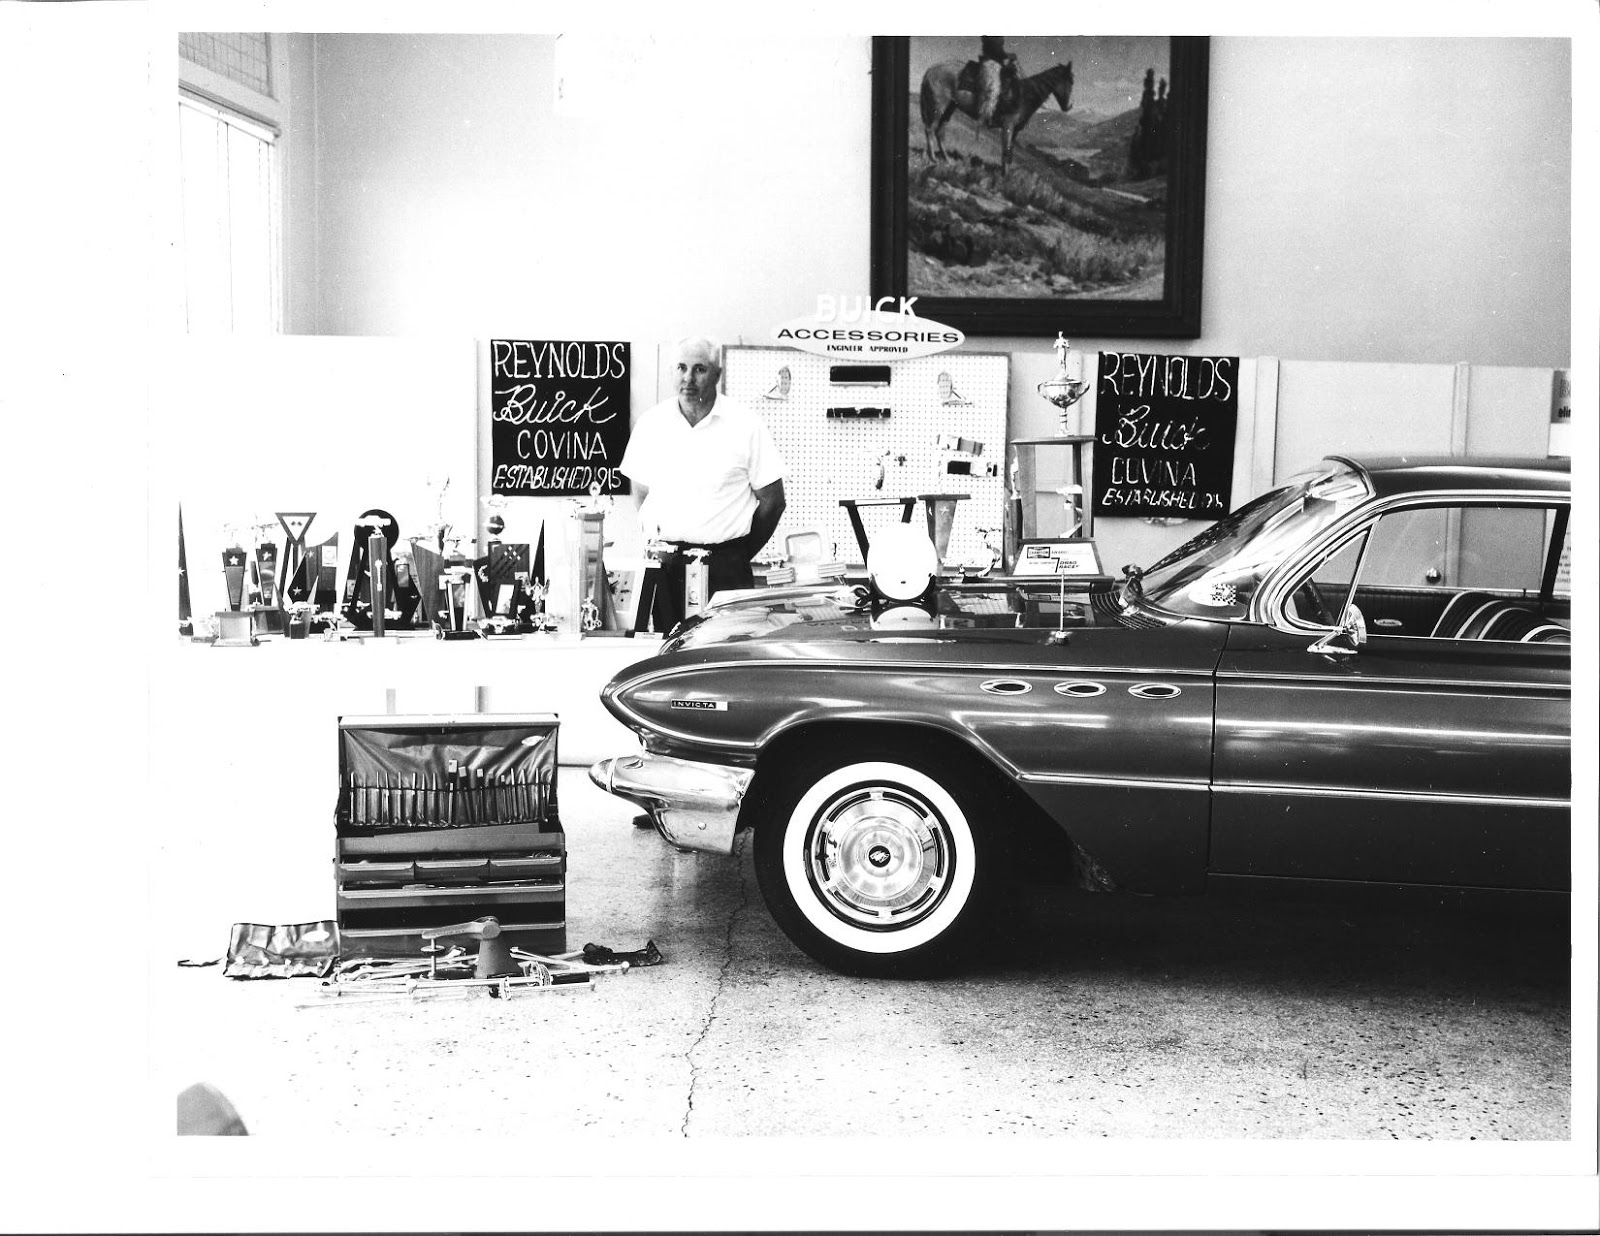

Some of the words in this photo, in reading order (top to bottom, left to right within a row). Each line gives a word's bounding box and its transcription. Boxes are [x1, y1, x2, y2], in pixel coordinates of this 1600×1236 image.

[816, 294, 919, 323] BUICK
[777, 328, 959, 343] ACCESSORIES
[826, 344, 863, 352] ENGINEER
[869, 345, 908, 353] APPROVED
[492, 340, 626, 379] REYNOLDS
[1101, 351, 1231, 401] REYNOLDS
[493, 384, 617, 425] Buick
[1102, 404, 1211, 450] Buick
[518, 429, 607, 460] COVINA
[493, 464, 592, 489] ESTABLISHED
[1112, 456, 1197, 487] COVINA
